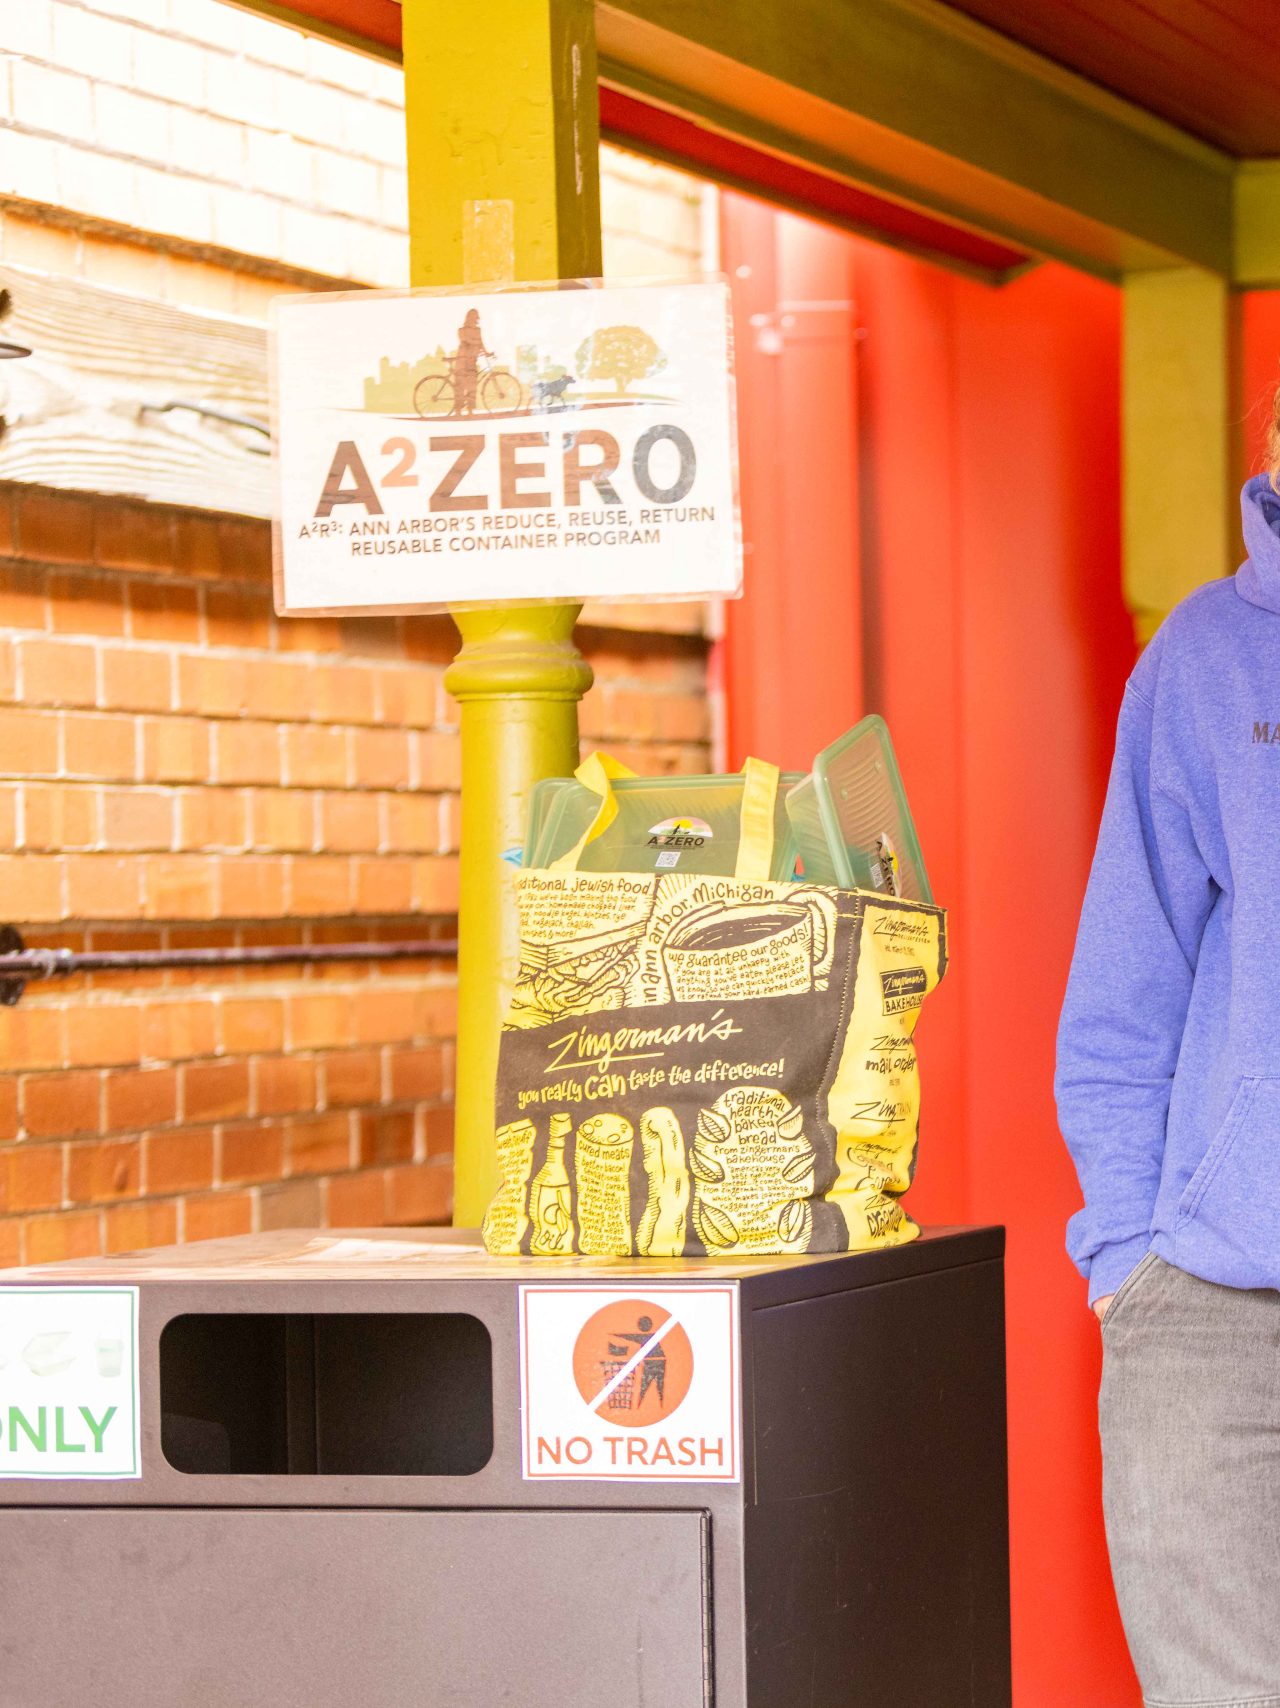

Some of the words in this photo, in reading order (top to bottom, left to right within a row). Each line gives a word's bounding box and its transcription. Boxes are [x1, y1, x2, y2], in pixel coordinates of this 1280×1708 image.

[349, 520, 390, 536] ANN
[397, 516, 475, 535] ARBOR'S
[482, 513, 562, 531] REDUCE,
[568, 510, 632, 527] REUSE,
[640, 507, 715, 524] RETURN
[351, 538, 442, 556] REUSABLE
[449, 533, 557, 552] CONTAINER
[564, 529, 661, 547] PROGRAM
[617, 877, 652, 896] food
[668, 952, 685, 965] we
[686, 949, 748, 969] guarantee
[750, 945, 768, 957] our
[769, 922, 810, 956] goods!
[641, 949, 662, 985] ann
[643, 986, 658, 1003] in
[544, 1009, 743, 1074] Zingerman's
[865, 1057, 892, 1075] mail
[518, 1089, 539, 1109] you
[541, 1079, 582, 1103] really
[627, 1066, 666, 1091] taste
[668, 1065, 691, 1086] the
[694, 1058, 785, 1083] difference!
[724, 1090, 786, 1113] traditional
[734, 1119, 775, 1133] baked
[739, 1130, 777, 1145] bread
[603, 1146, 630, 1160] meats
[714, 1145, 738, 1155] from
[726, 1154, 786, 1164] bakehouse
[0, 1405, 118, 1452] NLY
[537, 1436, 593, 1465] NO
[603, 1436, 724, 1466] TRASH
